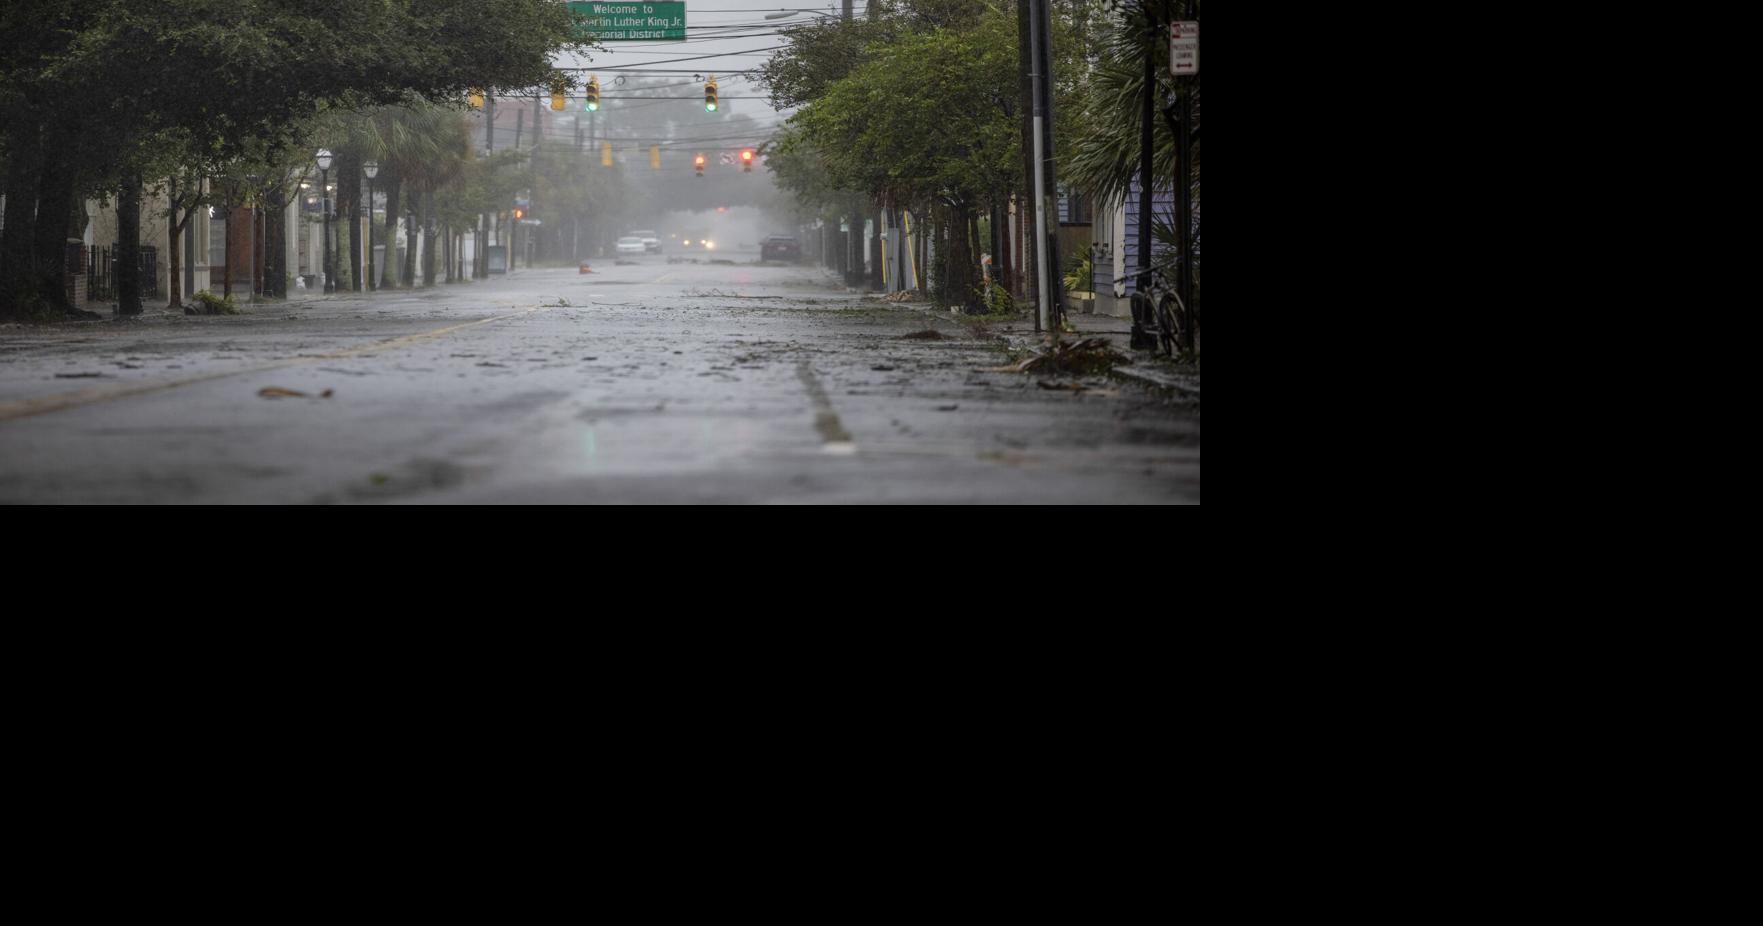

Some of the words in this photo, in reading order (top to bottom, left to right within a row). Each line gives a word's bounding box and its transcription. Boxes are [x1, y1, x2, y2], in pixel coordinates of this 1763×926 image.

[593, 4, 637, 14] Welcome
[643, 5, 653, 14] to
[614, 17, 644, 27] Luther
[647, 17, 669, 29] King
[671, 17, 682, 27] Jr.
[629, 30, 664, 38] District
